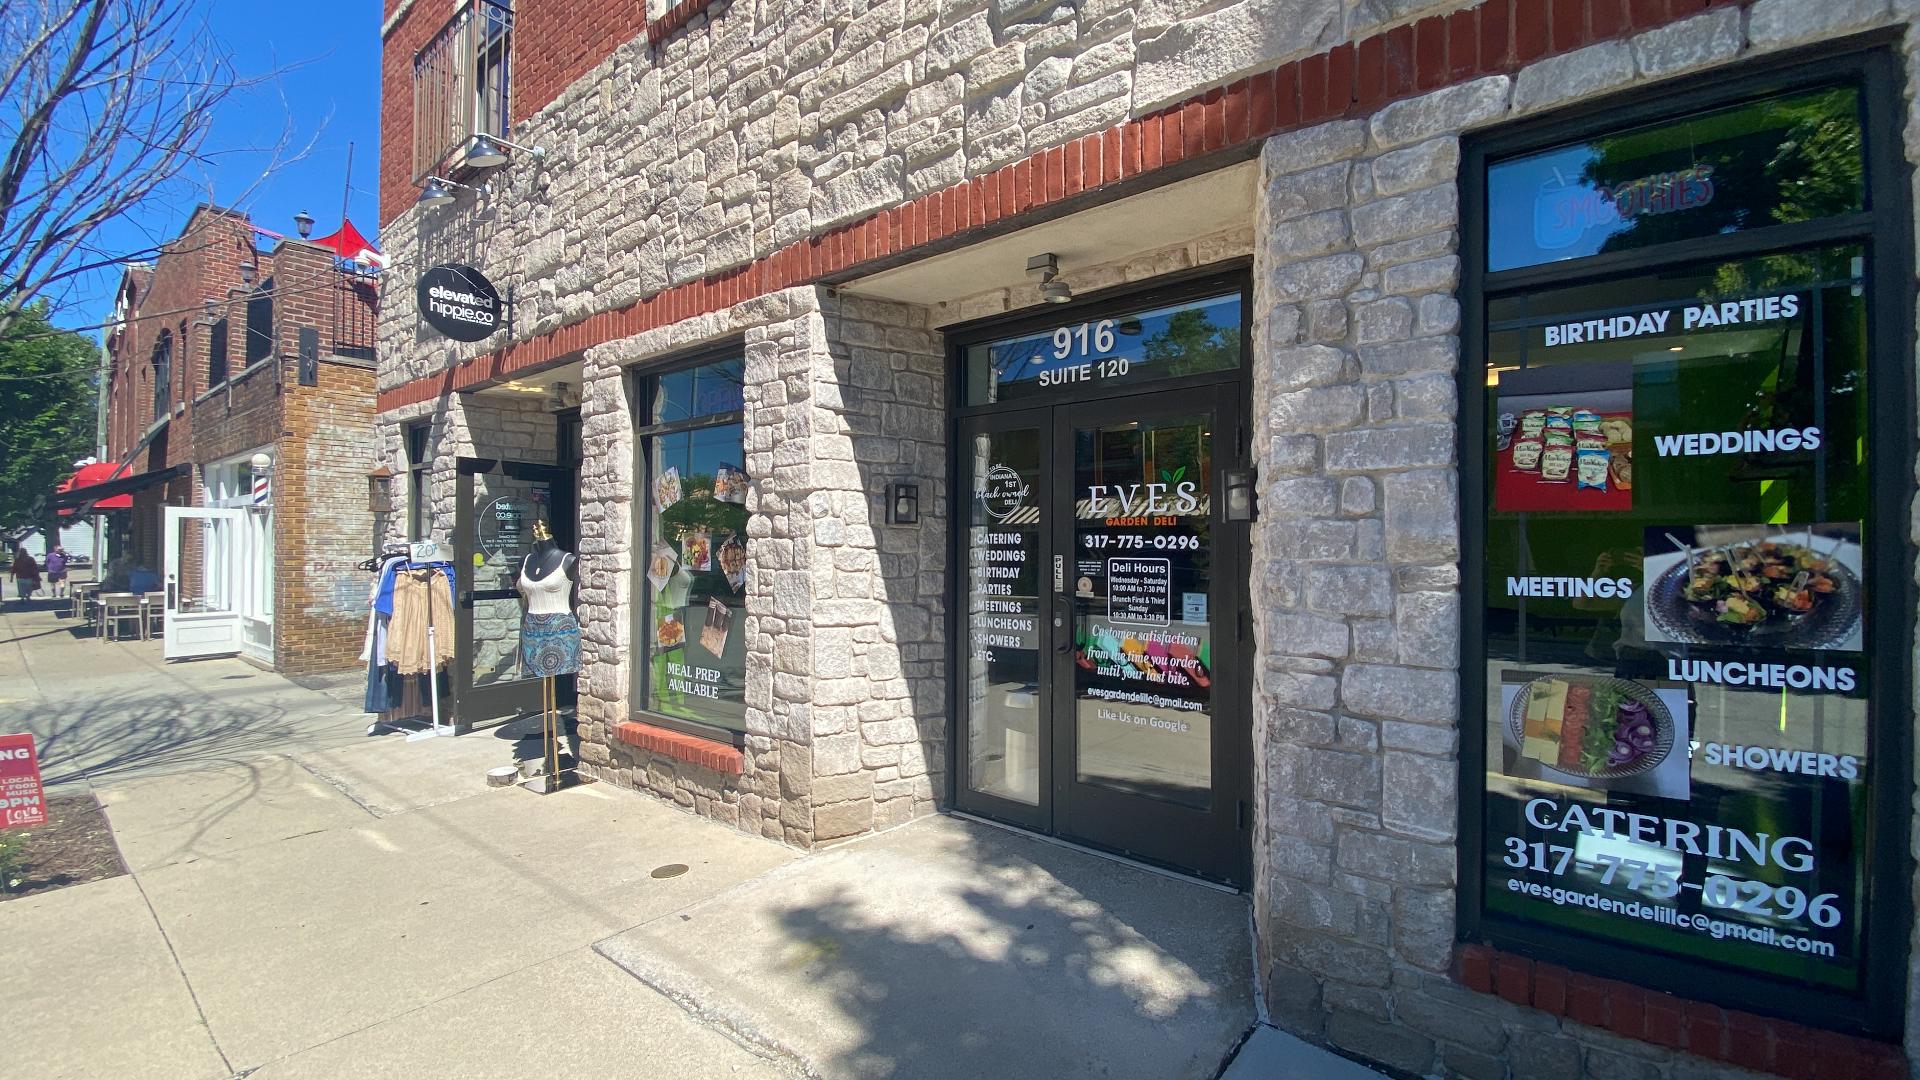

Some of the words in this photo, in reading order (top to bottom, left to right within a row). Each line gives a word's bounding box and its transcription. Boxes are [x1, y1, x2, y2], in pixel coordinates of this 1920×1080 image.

[1552, 164, 1714, 230] SMOOTHIES
[429, 285, 493, 309] elevated
[430, 298, 494, 320] hippie.co
[1544, 310, 1670, 347] BIRTHDAY
[1684, 294, 1799, 329] PARTIES
[1053, 319, 1115, 360] 916
[1039, 363, 1091, 387] SUITE
[1097, 358, 1129, 378] 120
[1654, 427, 1821, 457] WEDDINGS
[975, 486, 1001, 499] black
[1001, 484, 1030, 497] owned
[1088, 481, 1197, 513] EVES
[1105, 516, 1148, 526] GARDEN
[1153, 516, 1177, 526] DELI
[977, 533, 1022, 545] CATERING
[1085, 535, 1200, 550] 317-775-0296
[977, 550, 1026, 562] WEDDINGS
[977, 567, 1020, 579] BIRTHDAY
[1112, 562, 1131, 573] Deli
[1134, 562, 1166, 574] Hours
[977, 583, 1012, 596] PARTIES
[1110, 576, 1140, 585] Wednesday
[1143, 577, 1168, 587] Saturday
[1507, 576, 1633, 600] MEETINGS
[977, 599, 1022, 613] MEETINGS
[1112, 595, 1131, 603] Brunch
[1132, 596, 1145, 604] First
[1150, 596, 1166, 605] Third
[1128, 604, 1149, 613] Sunday
[977, 617, 1032, 632] LUNCHEONS
[977, 633, 1021, 648] SHOWERS
[1091, 624, 1136, 641] Customer
[1137, 629, 1198, 647] satisfaction
[977, 649, 996, 663] ETC.
[1087, 647, 1109, 661] from
[1110, 650, 1126, 662] the
[1127, 650, 1149, 664] time
[1150, 656, 1168, 668] you
[1169, 655, 1202, 671] order,
[667, 662, 693, 678] MEAL
[695, 666, 721, 683] PREP
[1097, 666, 1121, 678] until
[1121, 669, 1144, 681] your
[1146, 669, 1166, 683] last
[1167, 672, 1190, 686] bite.
[1667, 658, 1856, 692] LUNCHEONS
[668, 678, 719, 700] AVAILABLE
[1087, 686, 1203, 712] evesgardendelillc@gmail.com
[1097, 709, 1116, 721] Like
[1118, 712, 1132, 723] Us
[1133, 716, 1147, 726] on
[1149, 717, 1188, 733] Google
[1704, 742, 1858, 779] SHOWERS
[2, 775, 37, 785] LOCAL
[8, 782, 38, 790] FOOD
[6, 788, 40, 797] MUSIC
[1524, 797, 1815, 873] CATERING
[1503, 836, 1842, 928] 317-775-0296
[1507, 877, 1836, 957] evesgardendelillc@gmail.com
